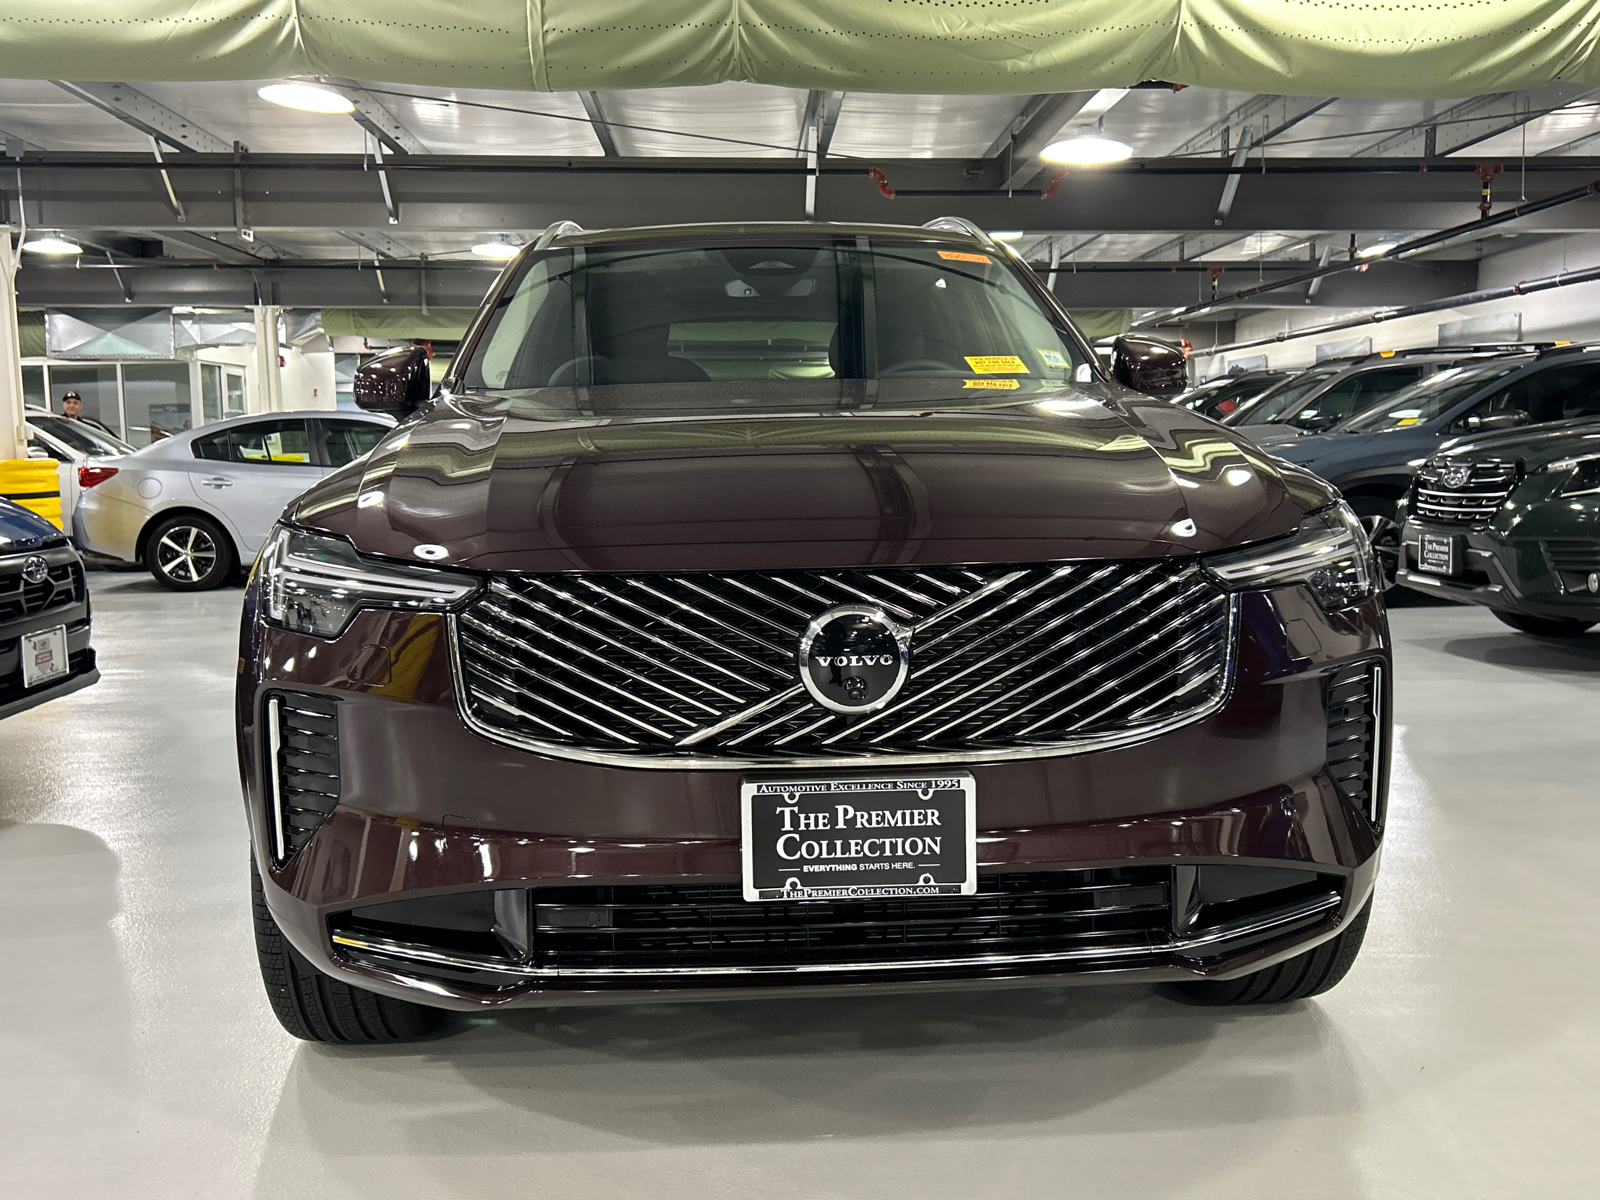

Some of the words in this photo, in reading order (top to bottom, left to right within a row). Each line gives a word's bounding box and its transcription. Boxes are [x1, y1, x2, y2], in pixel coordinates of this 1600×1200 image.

[815, 654, 893, 667] VOLVO
[758, 783, 828, 794] AUTOMOTIVE
[830, 782, 894, 792] EXCELLENCE
[896, 780, 928, 790] SINCE
[931, 779, 959, 789] 1995
[776, 806, 831, 831] THE
[835, 804, 942, 829] PREMIER
[776, 833, 942, 861] COLLECTION
[803, 863, 858, 873] EVERYTHING
[859, 862, 890, 871] STARTS
[891, 861, 916, 870] HERE.
[780, 885, 940, 899] THEPREMIERCOLLECTION.COM
